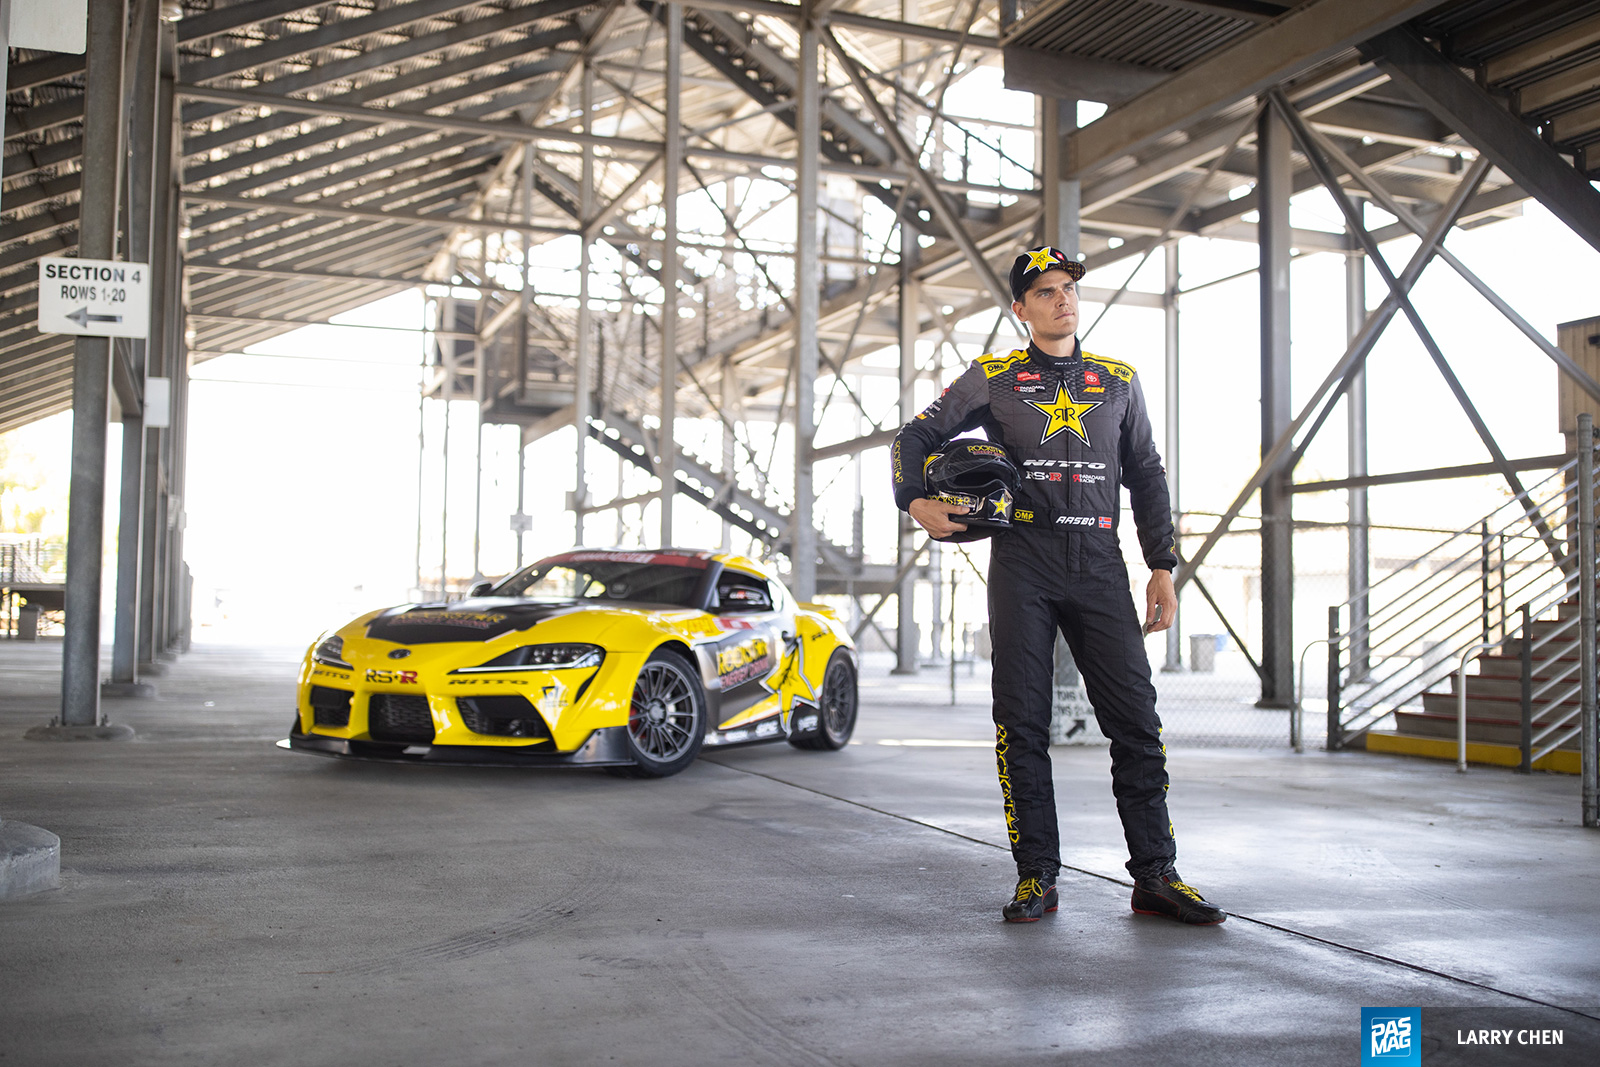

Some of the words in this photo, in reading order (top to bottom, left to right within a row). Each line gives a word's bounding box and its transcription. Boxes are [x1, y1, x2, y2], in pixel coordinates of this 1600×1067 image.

[45, 264, 125, 282] SECTION
[131, 270, 141, 284] 4
[61, 285, 97, 300] ROWS
[101, 288, 126, 302] 1-20
[986, 364, 1005, 372] OMP
[1022, 459, 1106, 470] NITTO
[1014, 511, 1034, 520] OMP
